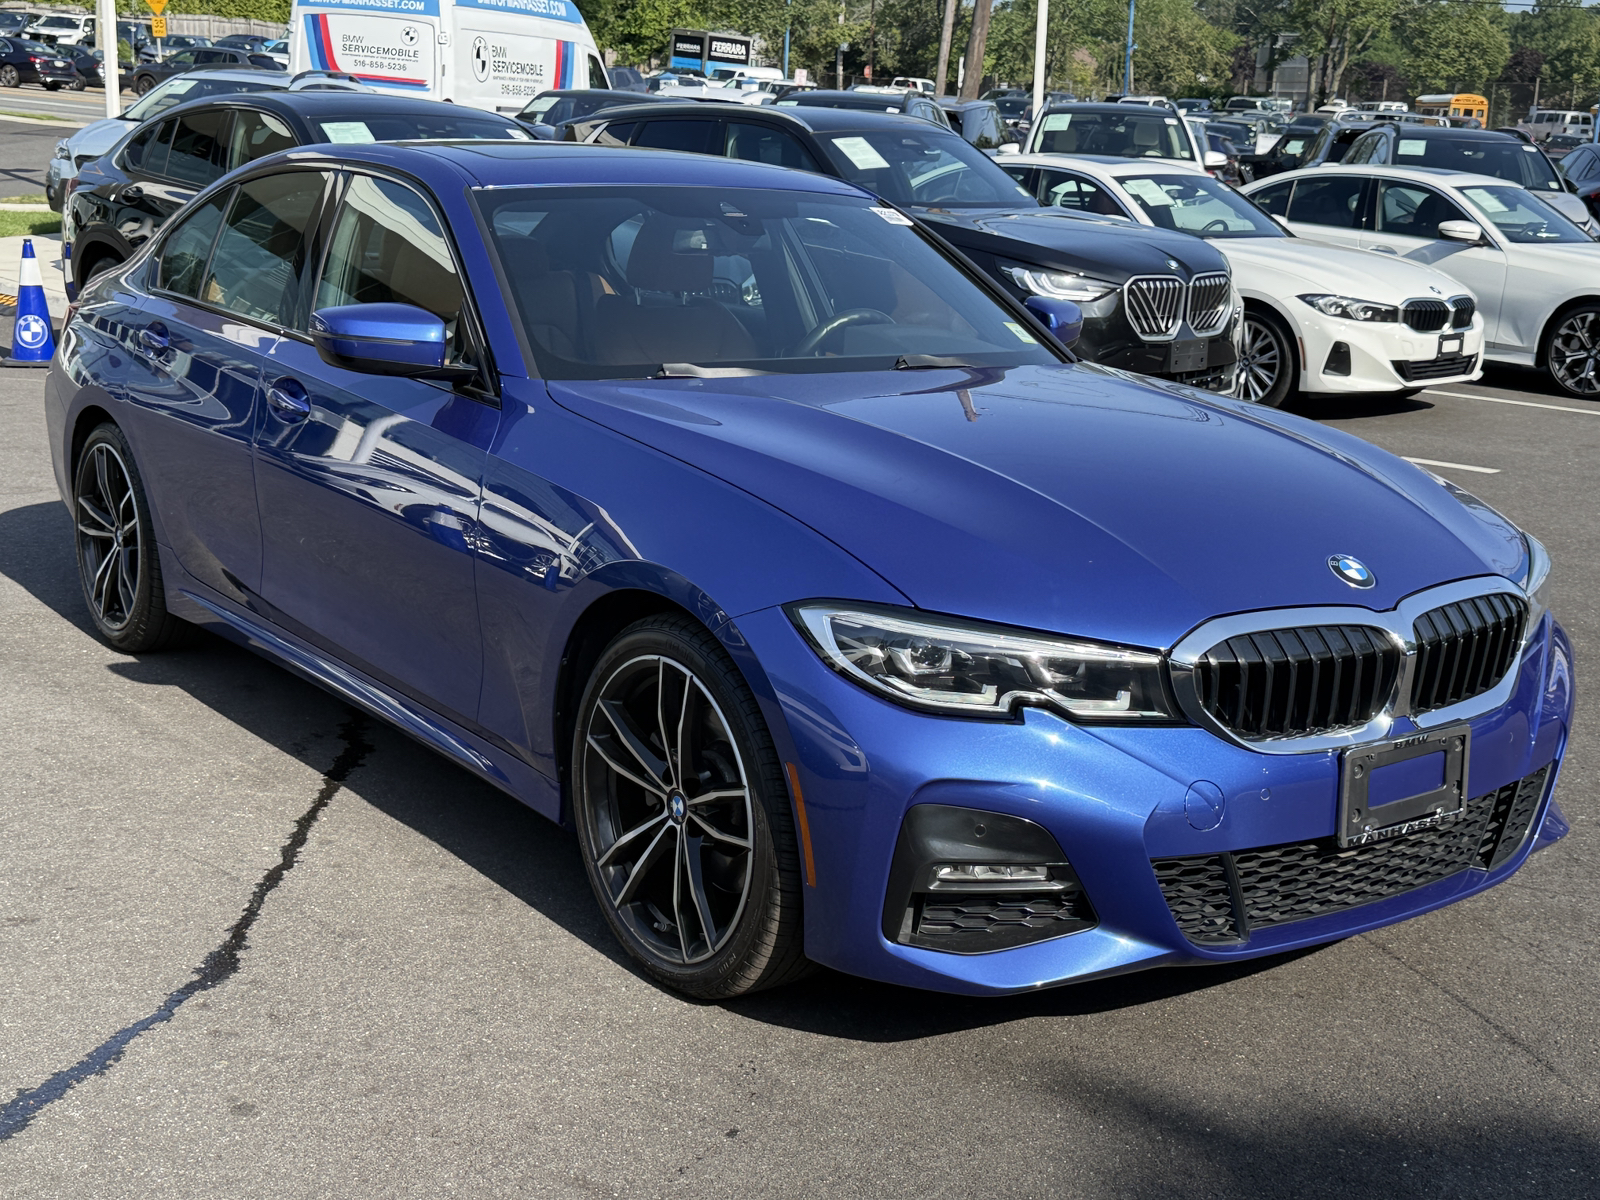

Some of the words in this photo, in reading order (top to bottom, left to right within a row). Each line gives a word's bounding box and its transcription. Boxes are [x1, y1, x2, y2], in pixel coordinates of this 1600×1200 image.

[308, 0, 425, 11] ANHASSET.COM
[154, 19, 164, 28] 35
[342, 34, 364, 44] BMW
[341, 43, 419, 59] SERVICEMOBILE
[711, 41, 746, 55] FERRARA
[492, 60, 544, 77] SERVICEMOBILE
[1393, 733, 1429, 750] BMW
